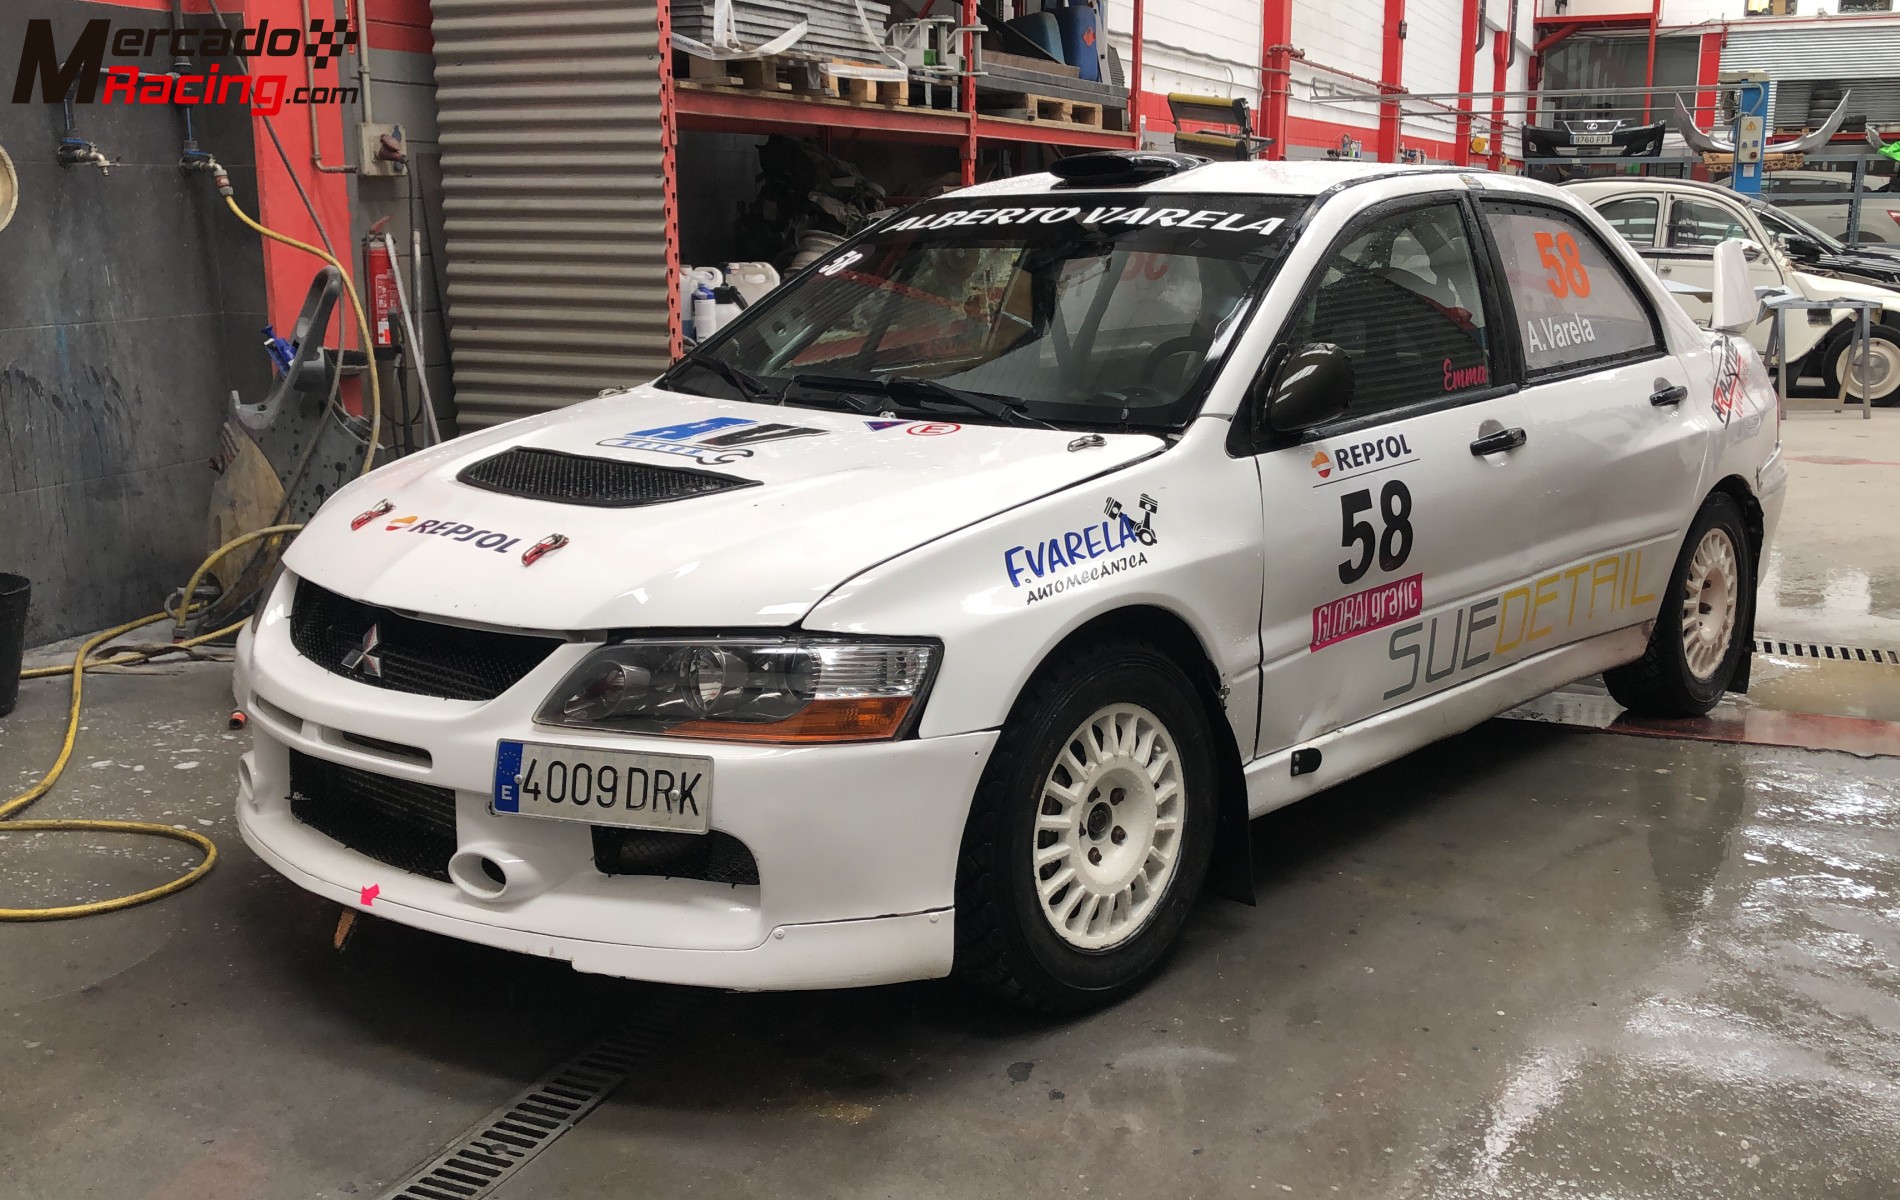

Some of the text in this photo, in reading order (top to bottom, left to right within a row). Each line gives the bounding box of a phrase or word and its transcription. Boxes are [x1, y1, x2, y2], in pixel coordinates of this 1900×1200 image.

[1575, 136, 1595, 144] 9760
[879, 206, 1286, 236] ALBERTO VARELA
[818, 250, 863, 276] 58
[1534, 231, 1591, 298] 58
[1527, 312, 1596, 354] A.Varela
[1442, 358, 1488, 392] Emma
[1334, 433, 1412, 472] REPSOL
[408, 519, 521, 554] REPSOL
[1338, 479, 1414, 585] 58
[1383, 550, 1656, 700] SUEDETAIL
[501, 785, 513, 800] E
[523, 758, 702, 816] 4009 DRK
